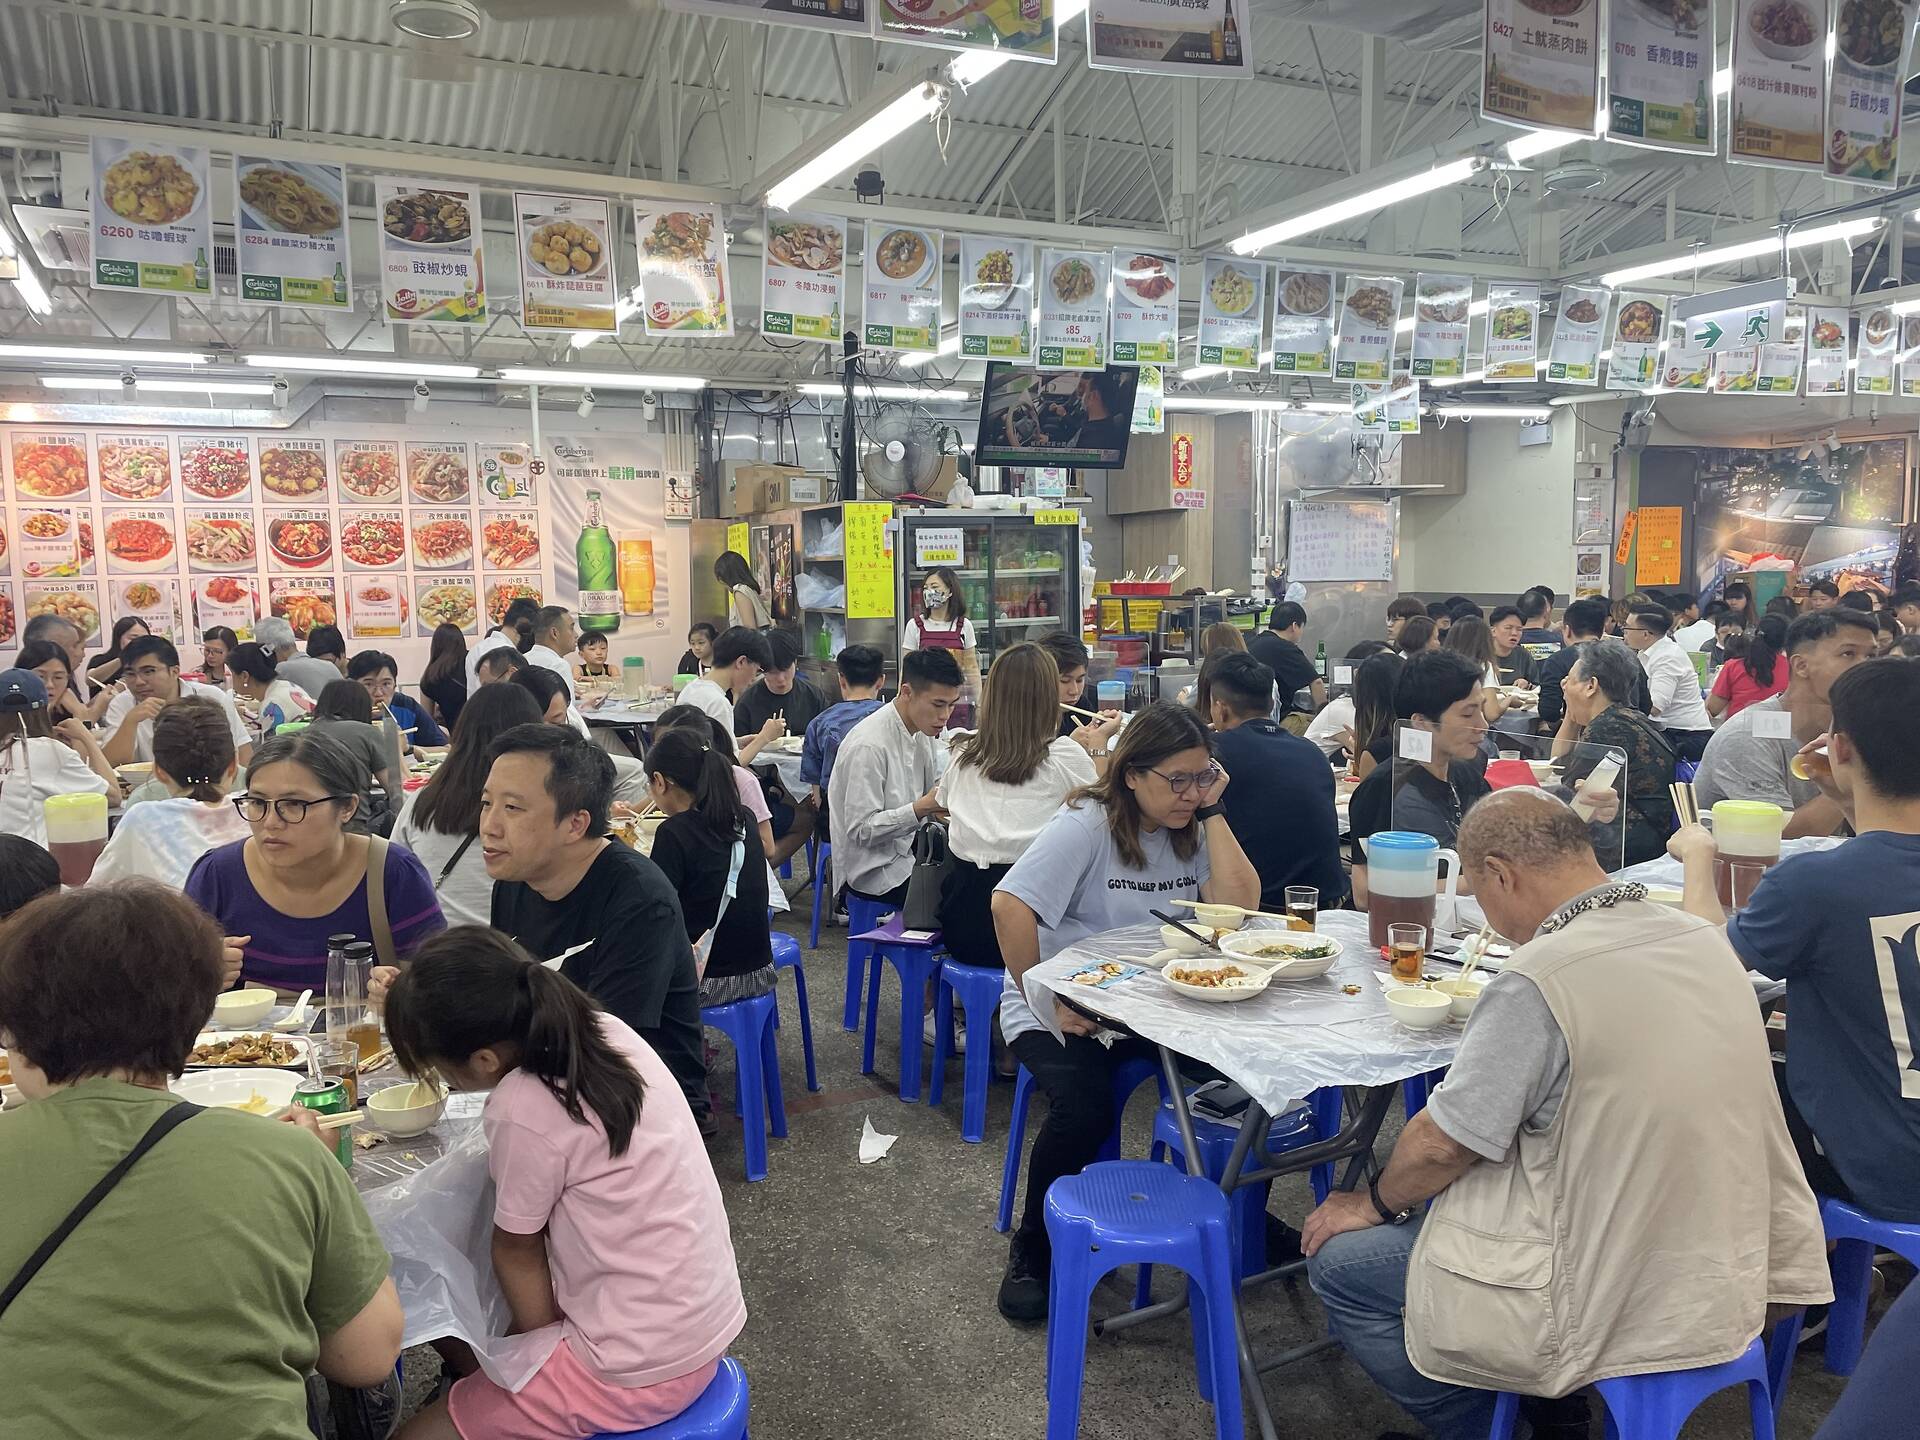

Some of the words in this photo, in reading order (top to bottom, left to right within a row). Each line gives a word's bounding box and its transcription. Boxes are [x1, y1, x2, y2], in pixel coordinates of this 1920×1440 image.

[1493, 21, 1514, 38] 6427
[1522, 27, 1589, 56] 土魷蒸肉餅
[1647, 44, 1698, 69] 香煎蠔餅
[100, 225, 134, 239] 6260
[138, 229, 188, 244] 咕嚕蝦球
[245, 235, 269, 245] 6284
[99, 263, 135, 278] Carlsberg
[388, 264, 408, 273] 6809
[412, 260, 468, 277] 豉椒炒蜆
[245, 278, 278, 291] Carlsberg
[546, 279, 603, 292] 酥炸琵琶豆腐
[768, 278, 786, 287] 6807
[396, 290, 417, 304] Jolly
[870, 291, 887, 300] 6817
[766, 314, 790, 325] Carlsberg
[868, 327, 891, 337] Carlsberg
[1065, 325, 1080, 335] $85
[555, 445, 587, 458] Carlsberg
[1177, 440, 1189, 482] 新春大吉
[769, 482, 781, 504] 3M
[42, 584, 73, 592] wasabi
[76, 583, 95, 592] 蝦球
[1137, 881, 1156, 892] KEEP
[1158, 880, 1174, 891] MY
